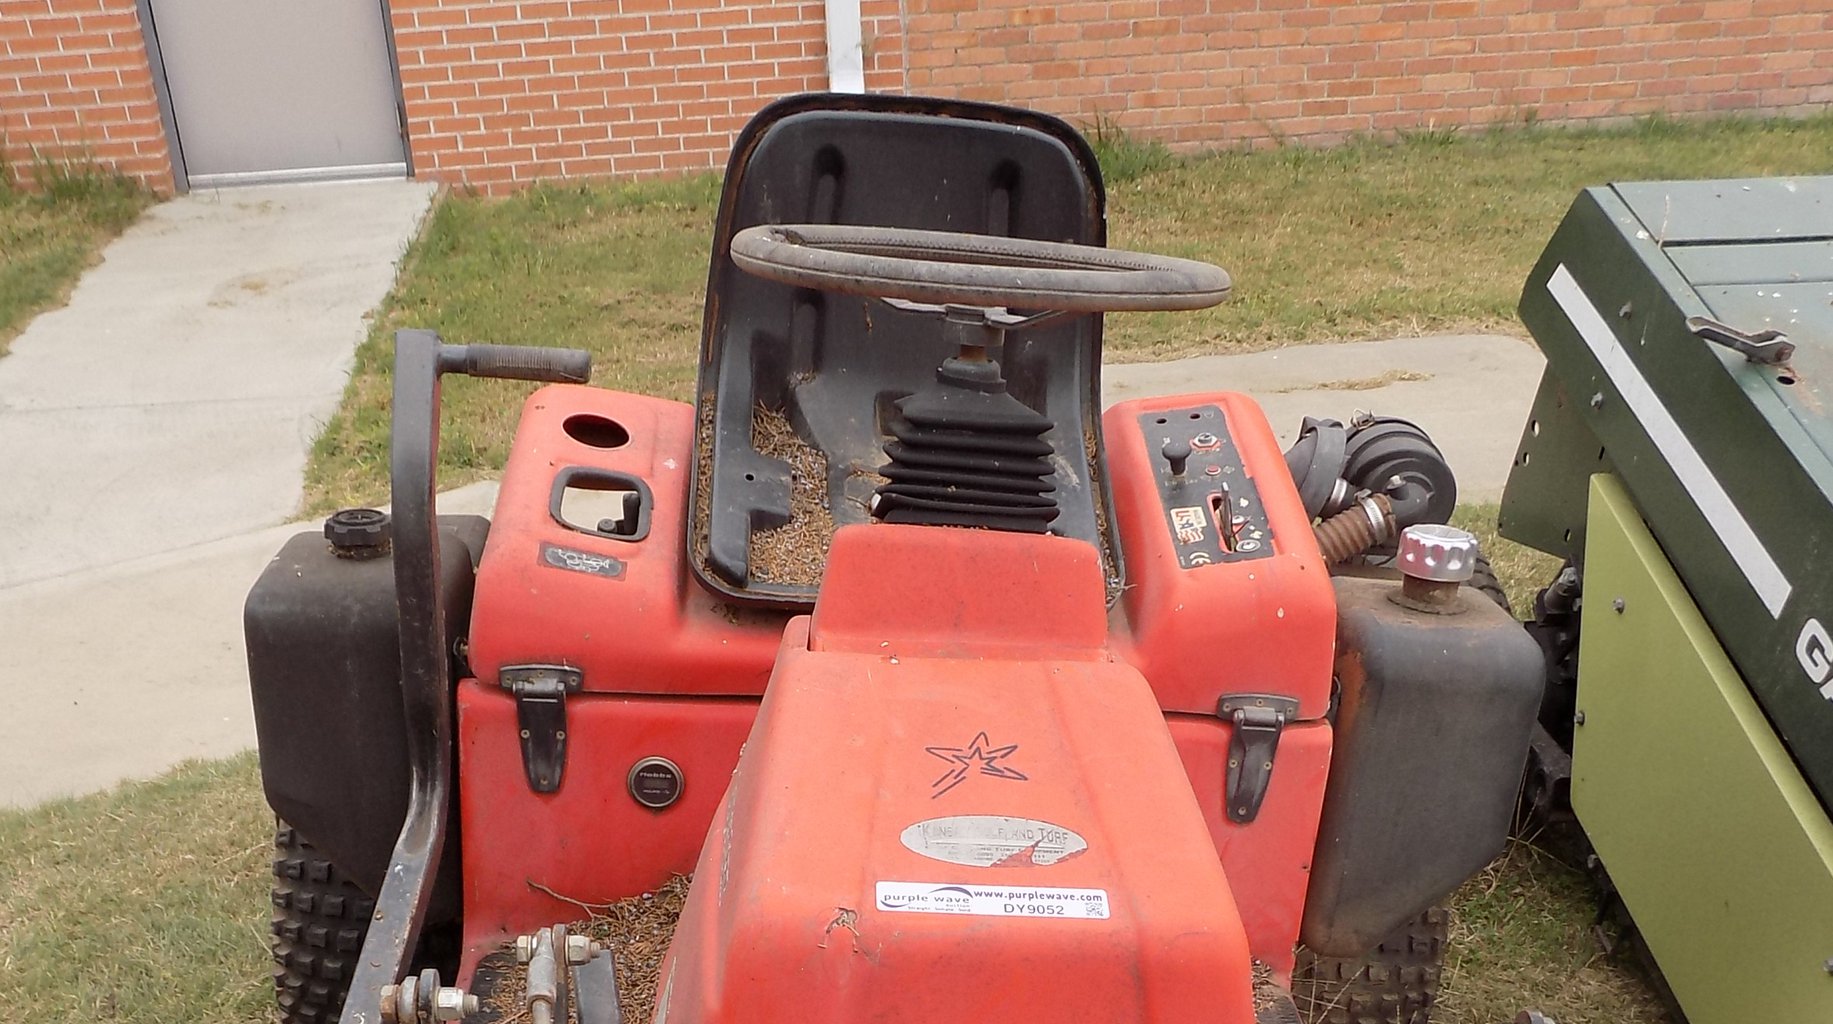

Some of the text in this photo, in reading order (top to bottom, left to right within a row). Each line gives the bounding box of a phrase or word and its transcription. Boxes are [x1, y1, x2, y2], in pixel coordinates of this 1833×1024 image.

[884, 893, 970, 904] purple wave
[973, 889, 1103, 902] www.purplewave.com
[1003, 903, 1065, 915] DY9052
